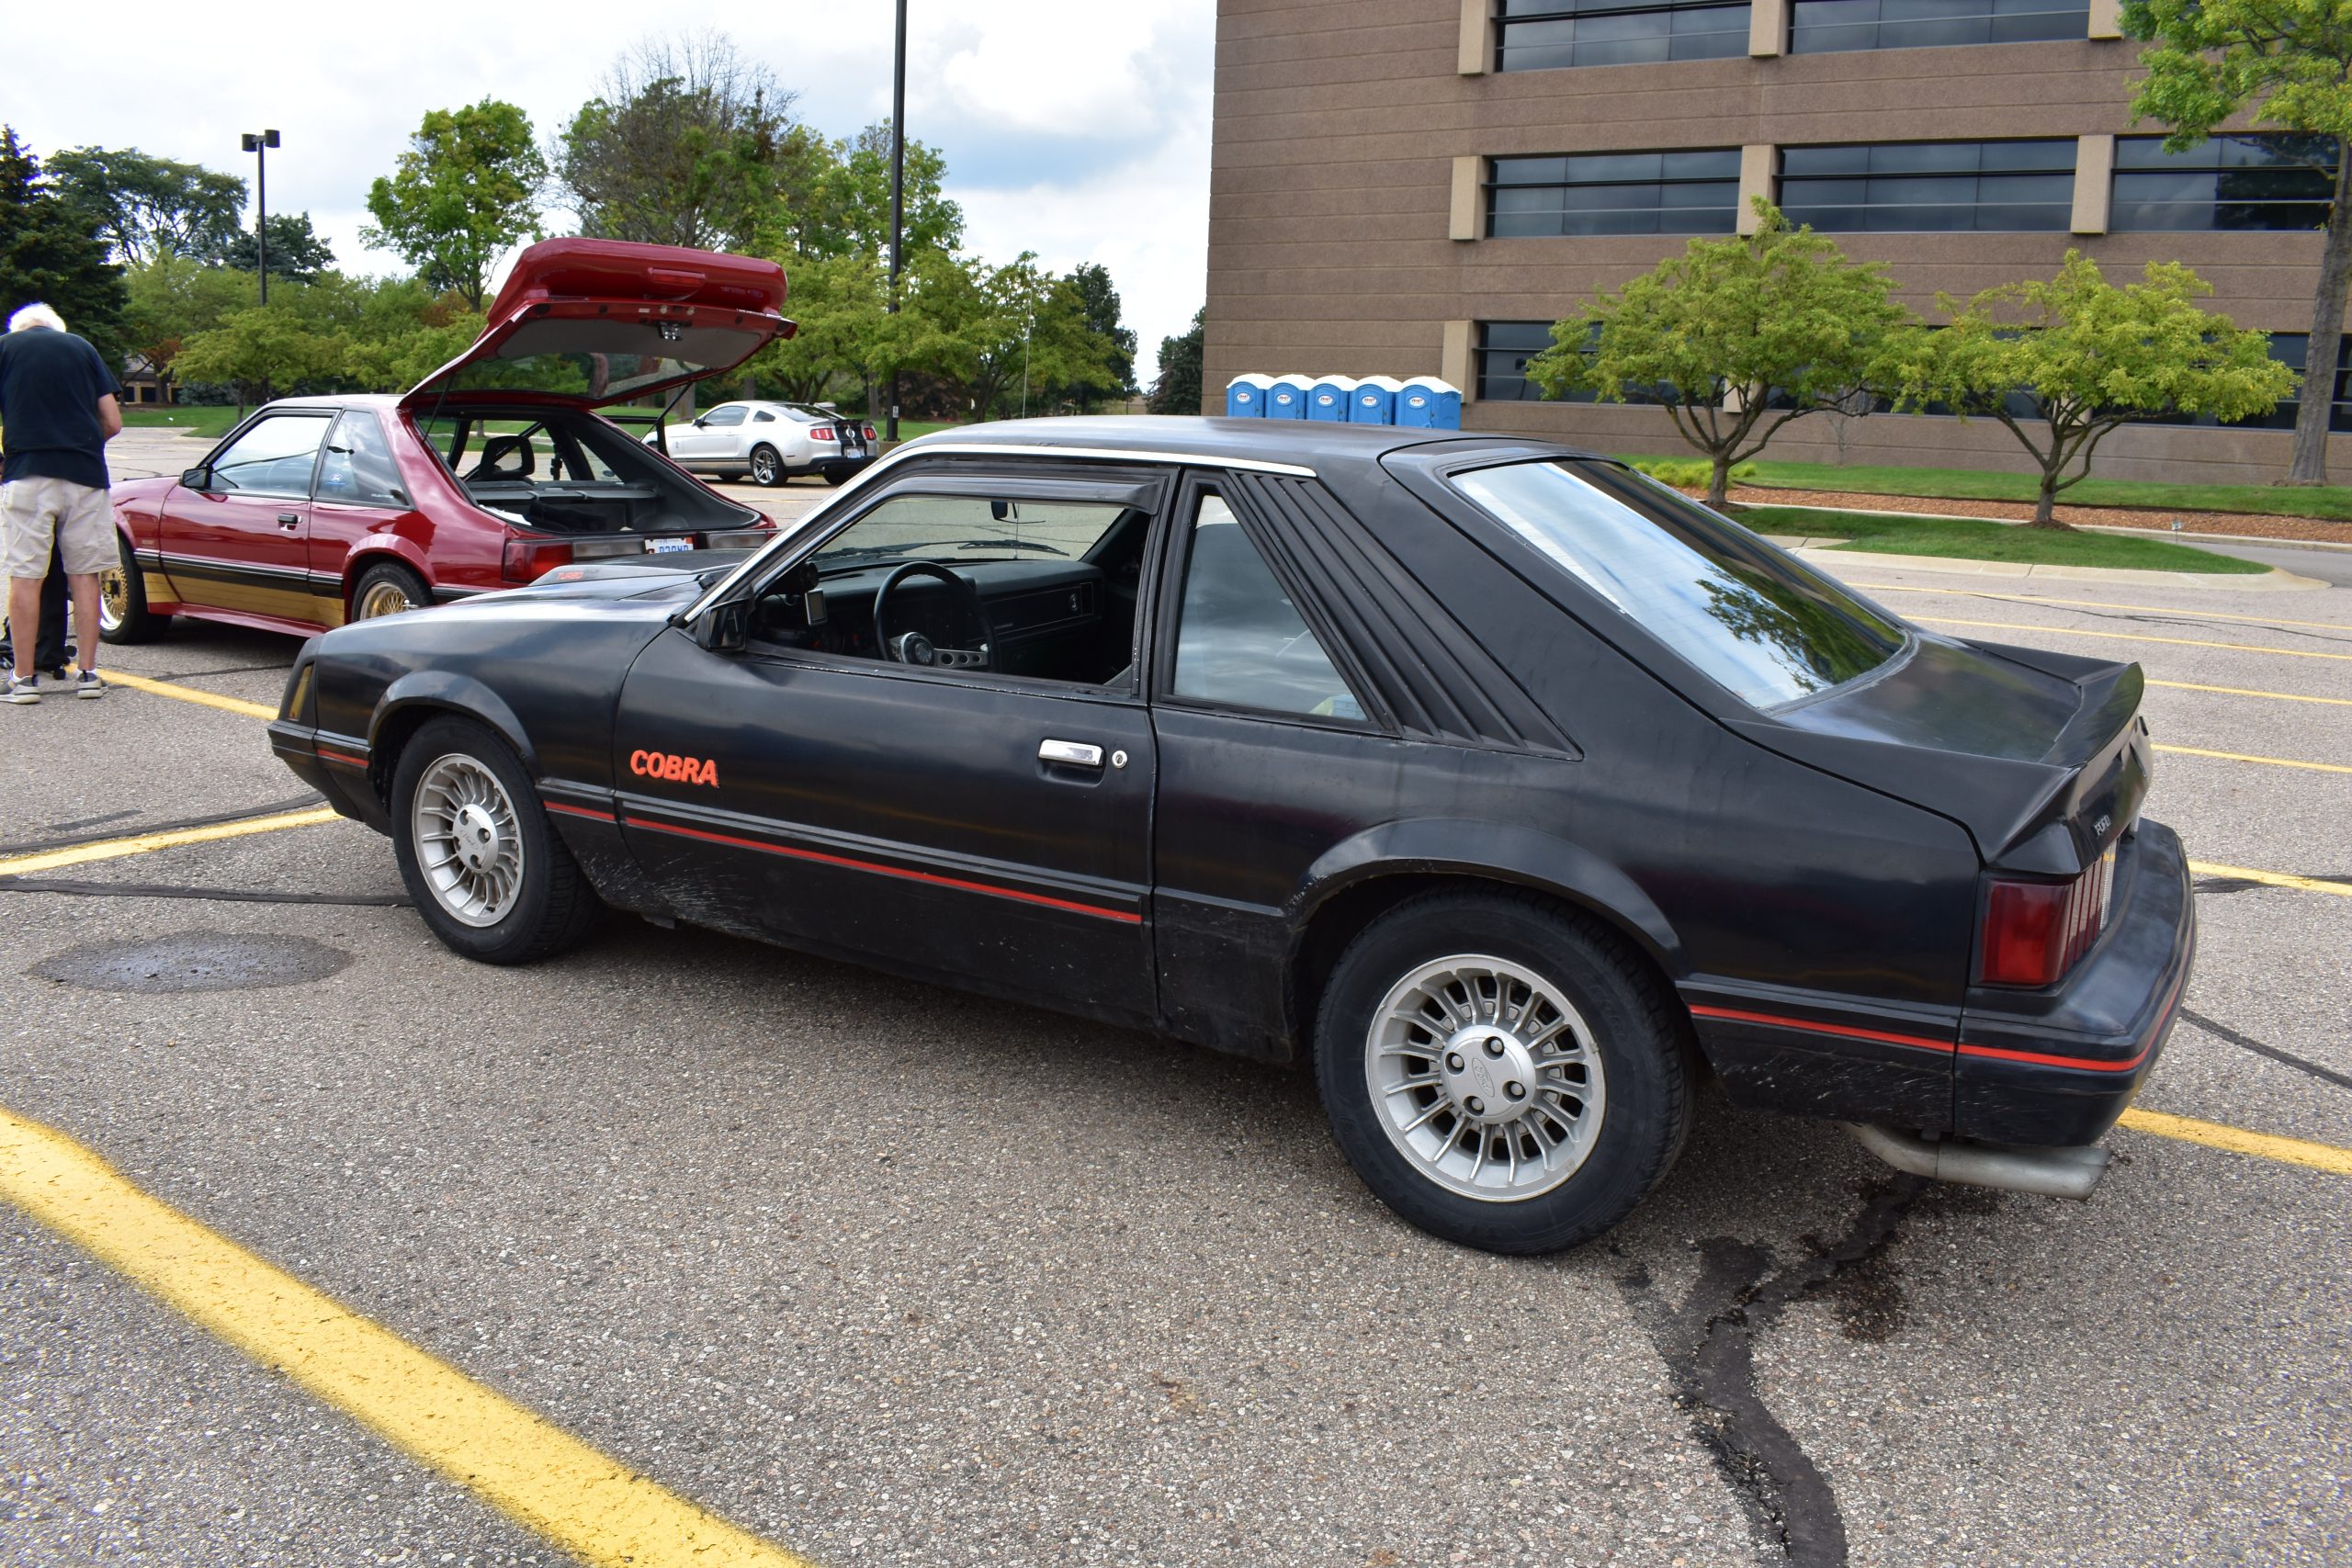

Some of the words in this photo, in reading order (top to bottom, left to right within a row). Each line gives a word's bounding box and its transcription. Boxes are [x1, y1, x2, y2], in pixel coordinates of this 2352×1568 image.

[559, 571, 583, 580] TURBO
[630, 750, 718, 787] COBRA
[2095, 815, 2110, 835] FORD
[1473, 1063, 1493, 1094] Ford
